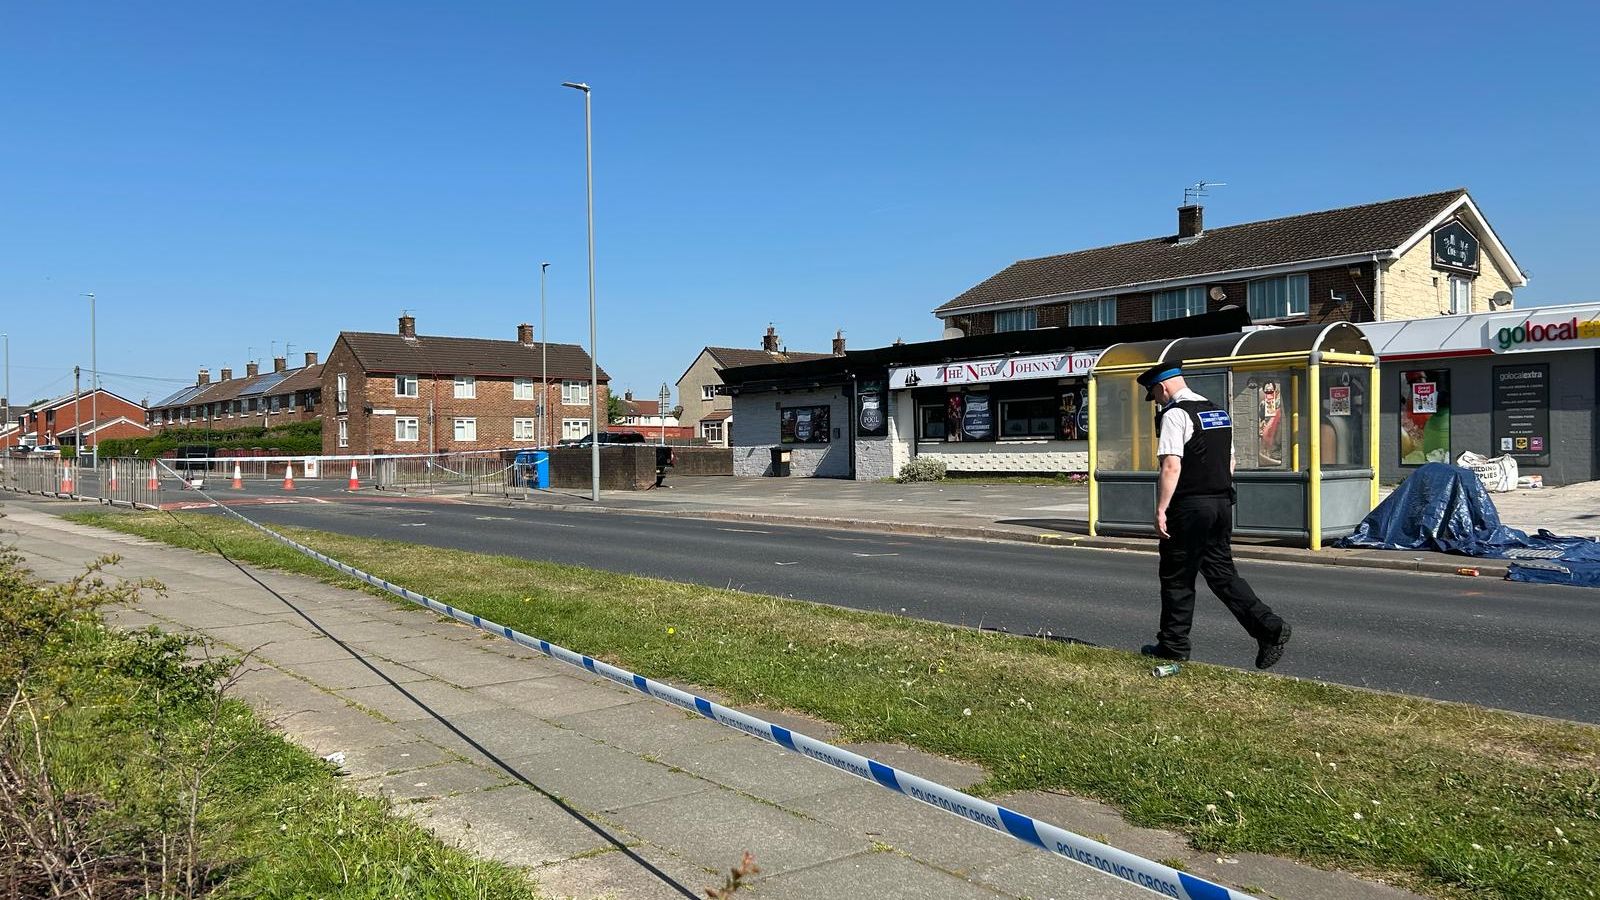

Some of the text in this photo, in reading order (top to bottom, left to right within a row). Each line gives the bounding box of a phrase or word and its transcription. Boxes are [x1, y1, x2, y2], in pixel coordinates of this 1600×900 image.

[1498, 317, 1577, 349] golocal
[1002, 359, 1059, 379] JOHNNY
[1061, 355, 1095, 373] TOD
[1499, 371, 1543, 381] golocalextra
[911, 787, 1000, 830] POLICE DO NOT CROSS
[1056, 842, 1180, 899] POLICE DO NOT CROSS
